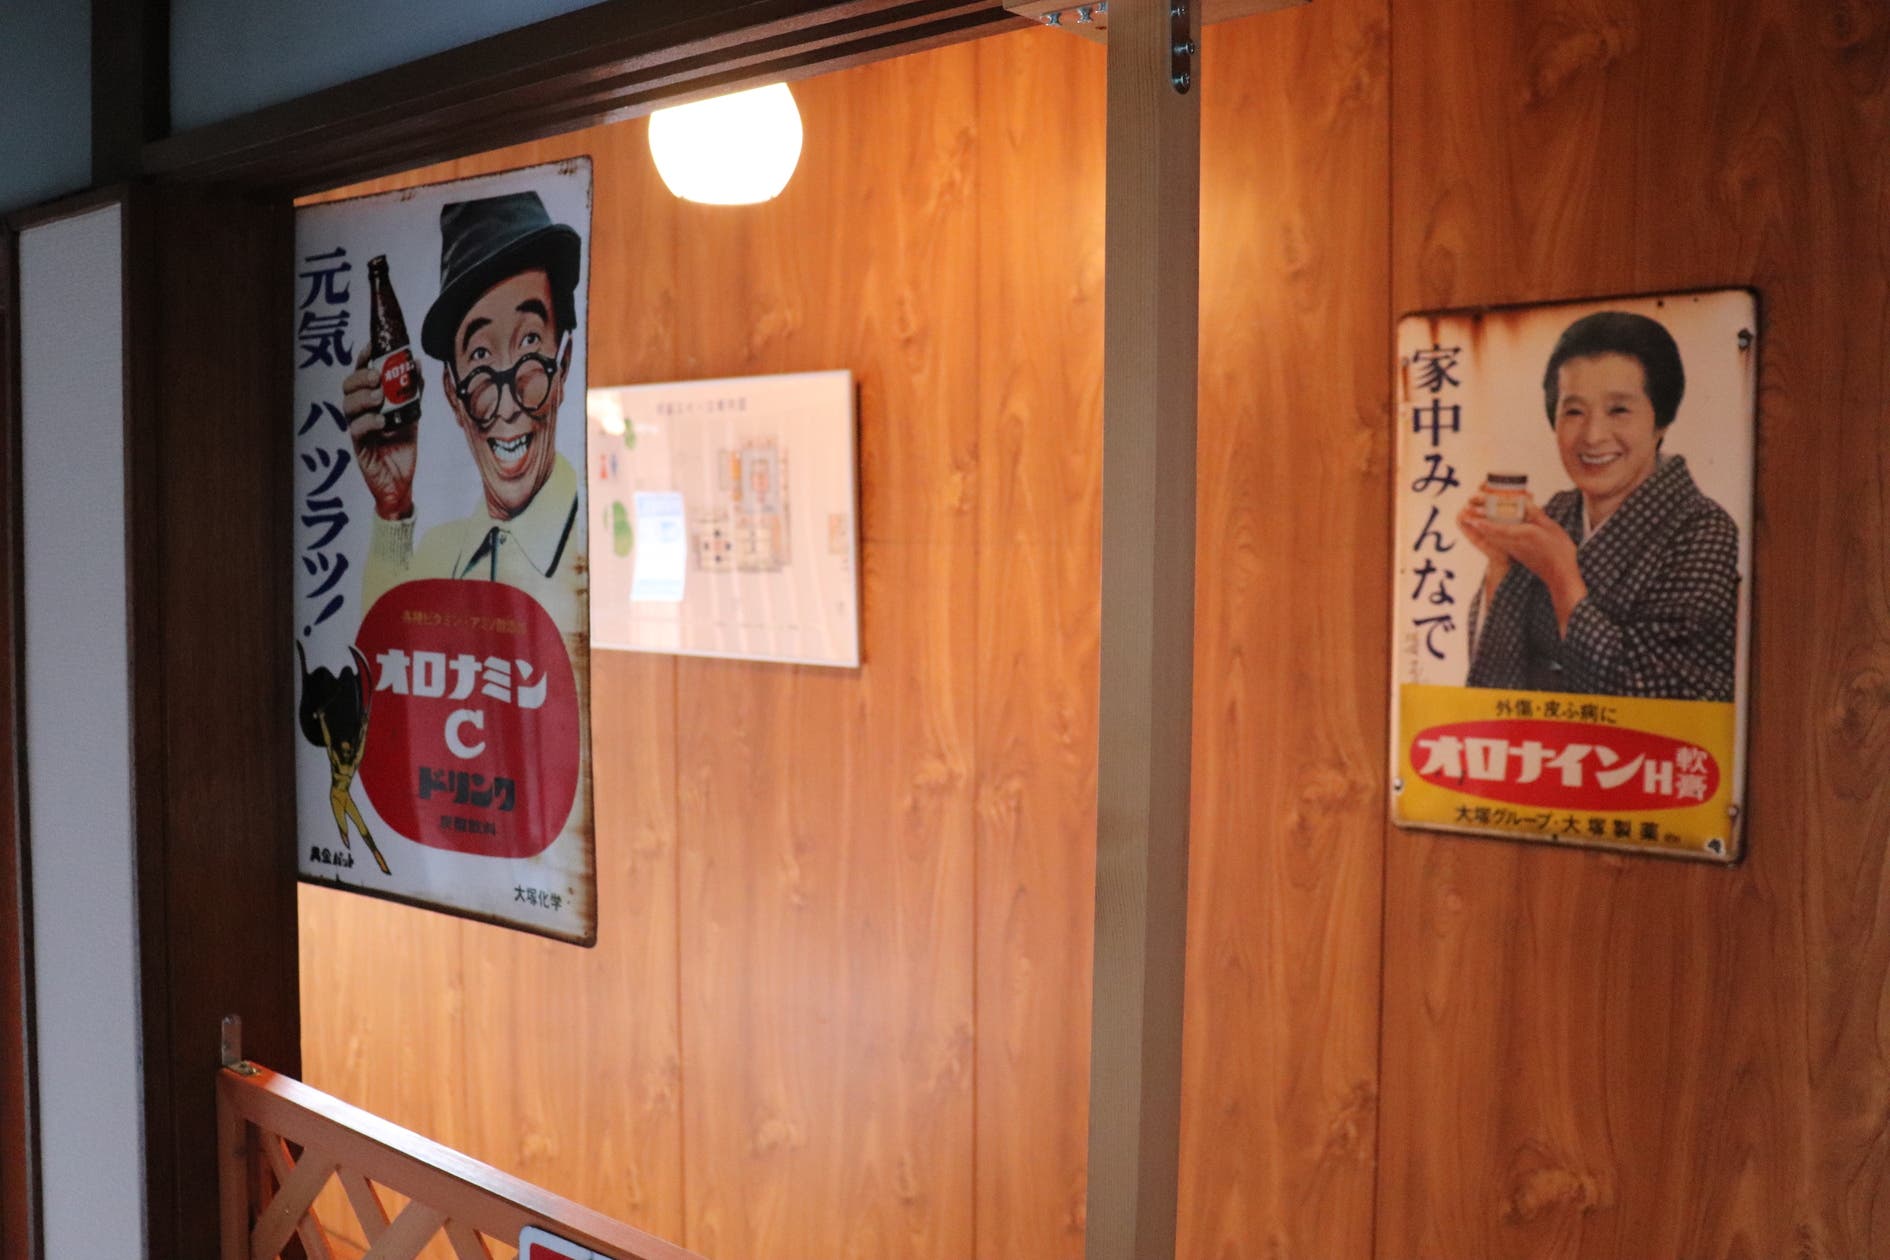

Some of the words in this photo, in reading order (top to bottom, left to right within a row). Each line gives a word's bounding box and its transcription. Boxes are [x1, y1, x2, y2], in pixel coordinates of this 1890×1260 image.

[298, 246, 353, 369] 元気
[298, 401, 350, 637] ハツラツ!
[1411, 343, 1462, 660] 家中みんなで
[375, 649, 548, 709] オロナミン
[444, 708, 486, 759] C
[1495, 699, 1617, 724] 外傷・皮ふ病に
[418, 766, 516, 812] ドリンク
[1417, 735, 1673, 795] オロナインH
[1675, 746, 1708, 801] 軟膏
[514, 884, 563, 911] 大塚化学
